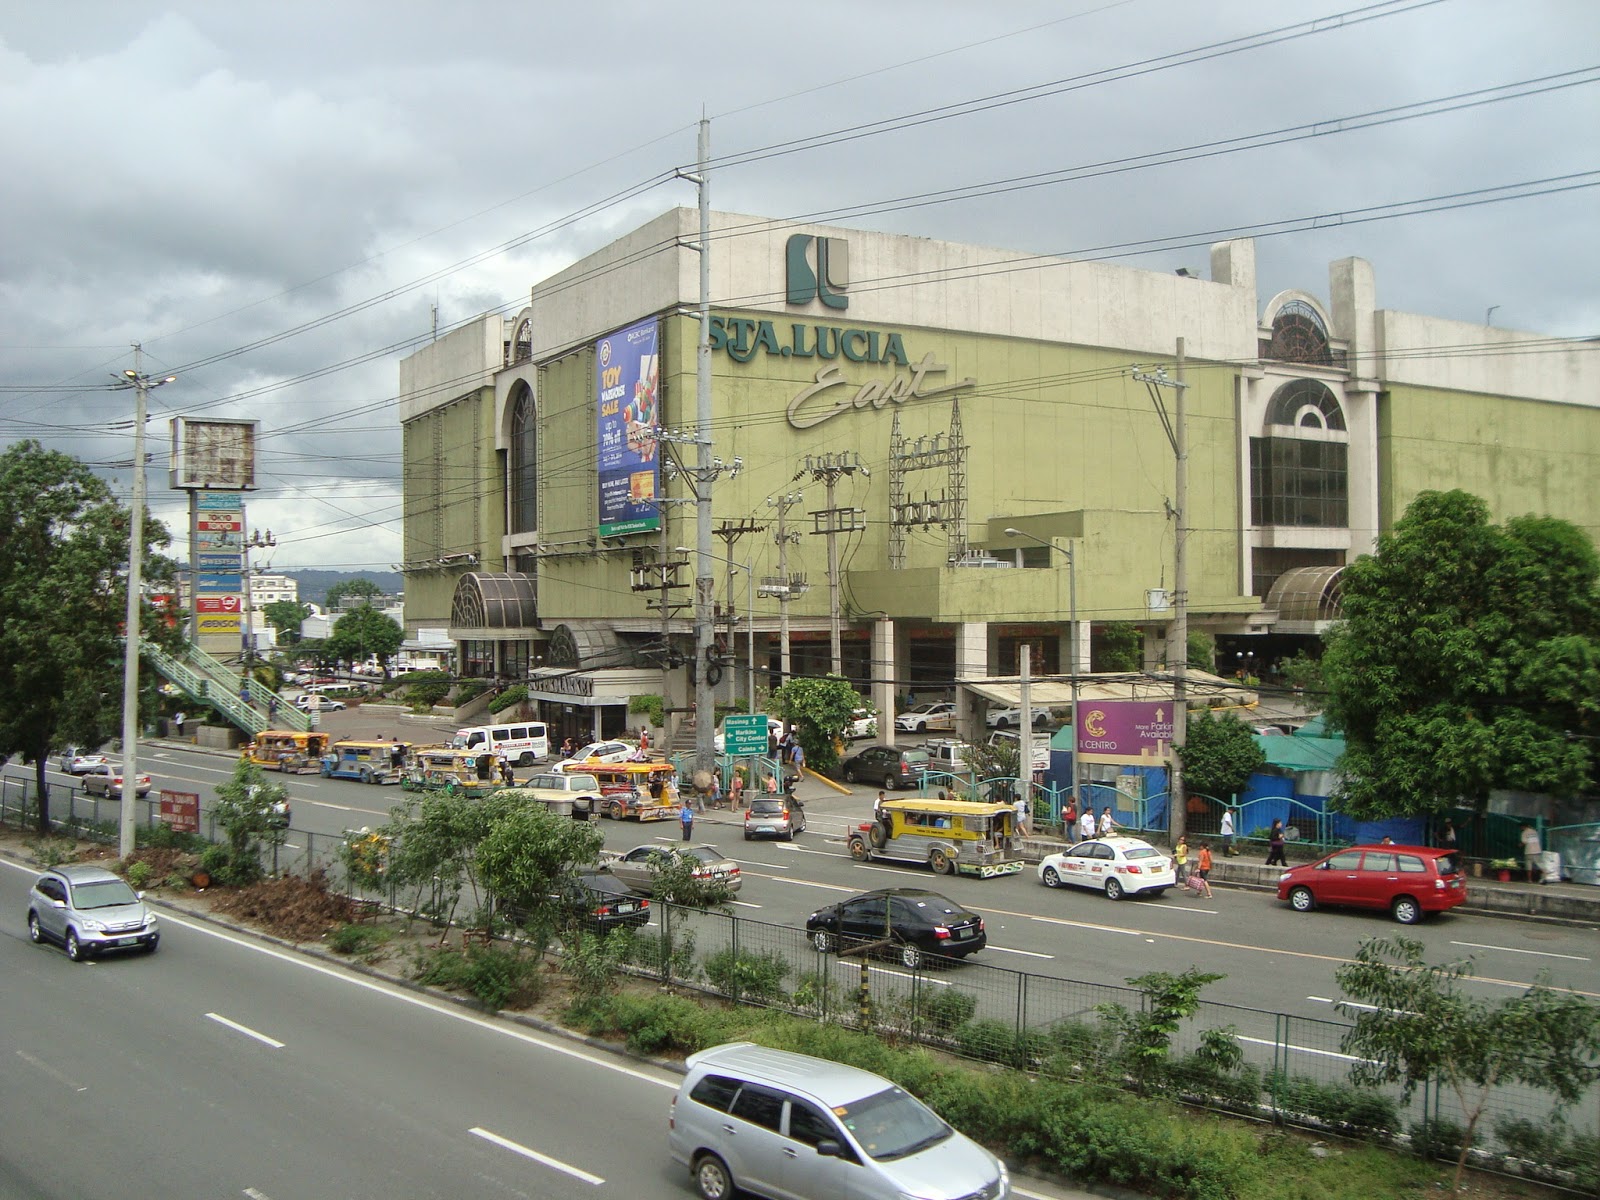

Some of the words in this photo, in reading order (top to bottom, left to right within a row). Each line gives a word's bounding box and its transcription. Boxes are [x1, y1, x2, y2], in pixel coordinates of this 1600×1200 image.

[602, 365, 621, 389] TOY
[601, 384, 626, 402] WAREHOUSE
[787, 352, 977, 429] East
[601, 400, 619, 418] SALE
[605, 421, 612, 432] up
[207, 522, 232, 530] TOKYO
[199, 620, 241, 628] ABENSON
[1151, 722, 1174, 731] Parkin
[1140, 730, 1174, 738] Availabl
[1085, 740, 1118, 750] CENTRO
[981, 861, 1025, 878] BOSS
